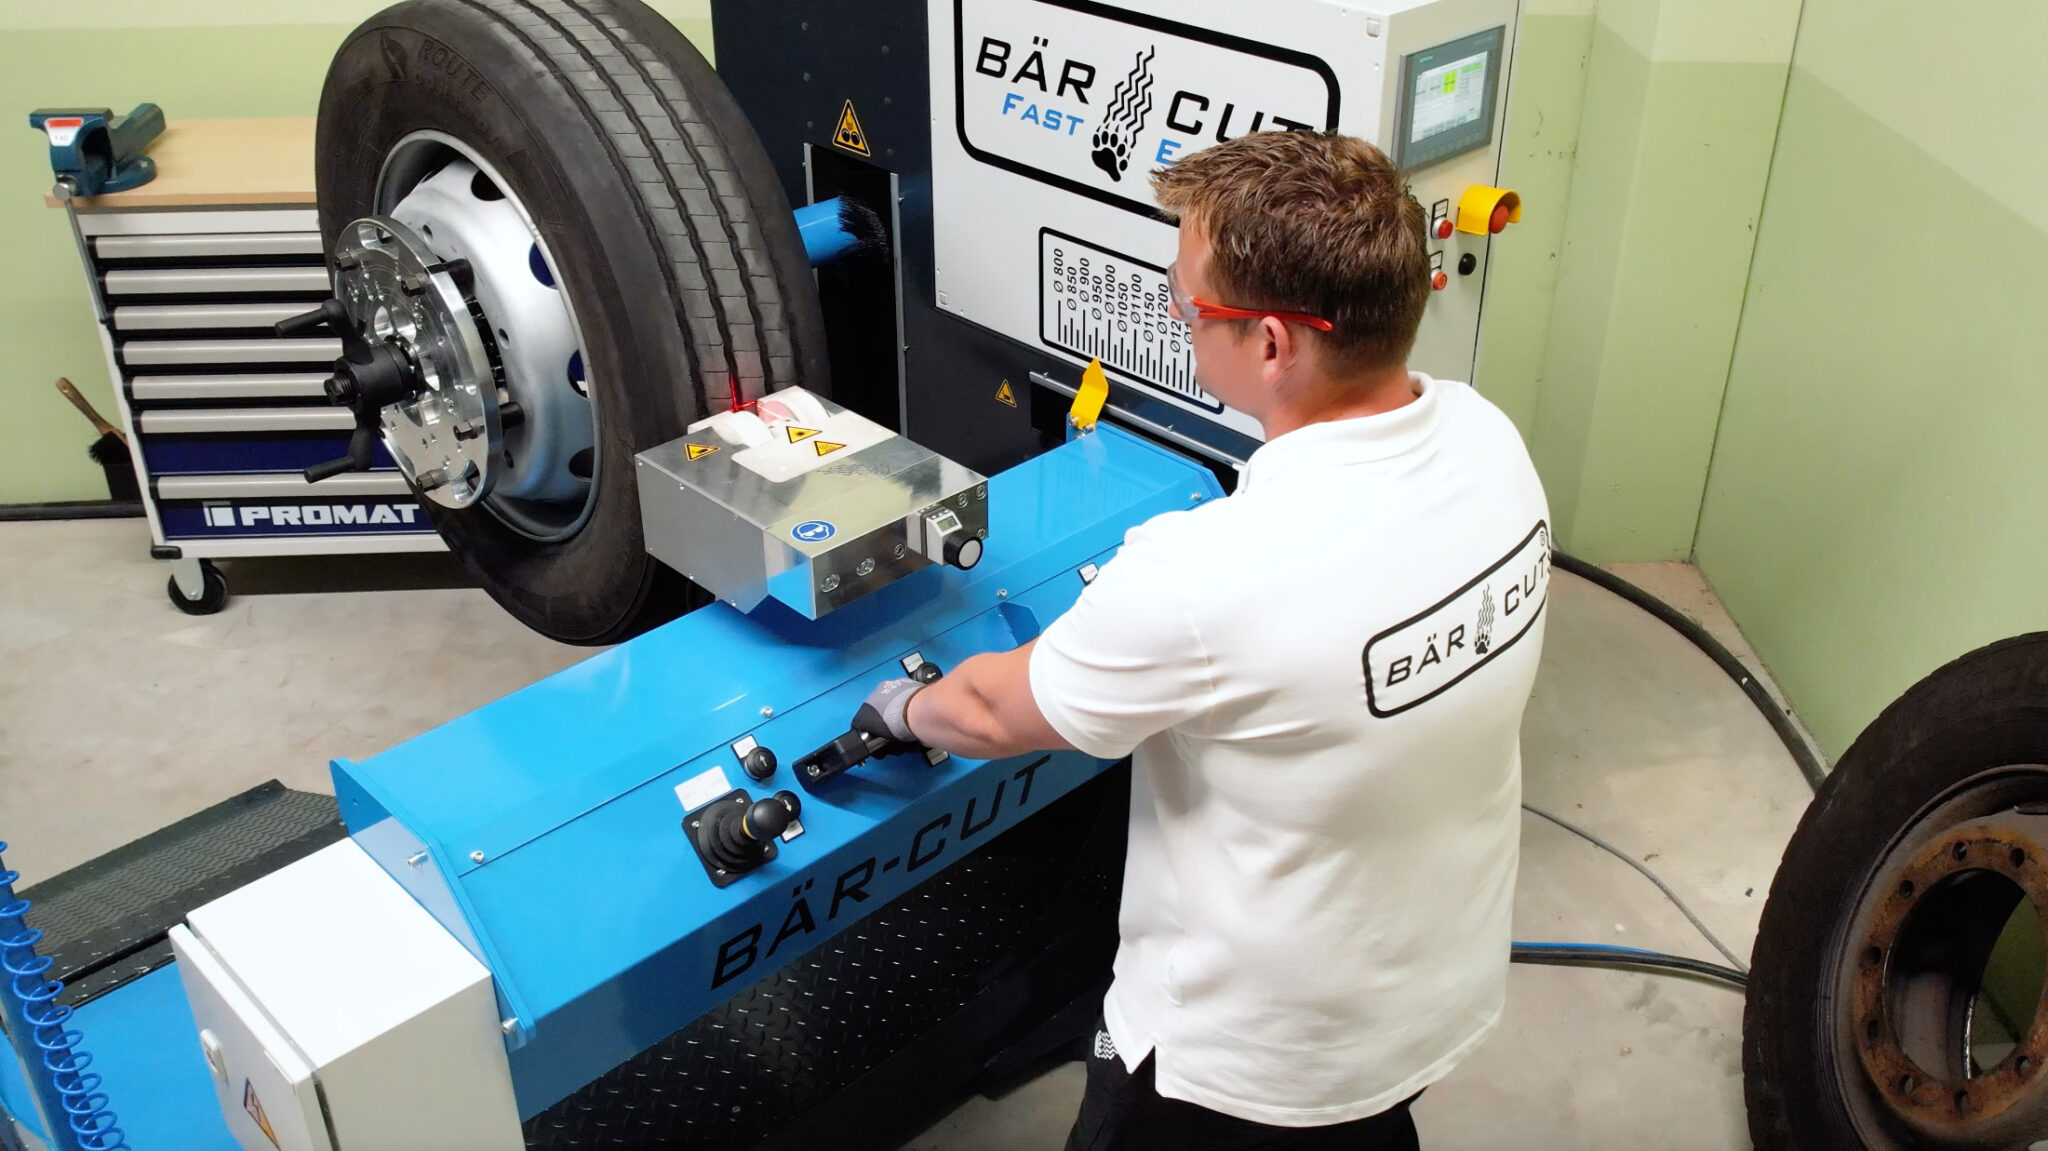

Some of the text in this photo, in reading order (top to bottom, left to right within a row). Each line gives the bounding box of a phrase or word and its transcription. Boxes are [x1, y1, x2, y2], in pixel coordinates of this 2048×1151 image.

[417, 38, 493, 104] ROUTE
[975, 35, 1096, 105] BÄR
[1002, 92, 1085, 137] FAST
[1053, 248, 1064, 277] 800
[1067, 266, 1078, 295] 850
[1079, 257, 1090, 286] 900
[1092, 275, 1103, 304] 950
[1104, 264, 1116, 315] Ø1000
[1117, 282, 1129, 333] Ø1050
[1130, 273, 1142, 325] Ø1100
[1143, 292, 1155, 343] Ø1150
[1169, 320, 1182, 353] Ø12
[239, 504, 420, 527] PROMAT
[1386, 552, 1547, 688] BÄR CUT
[710, 753, 1052, 991] BÄR-CUT
